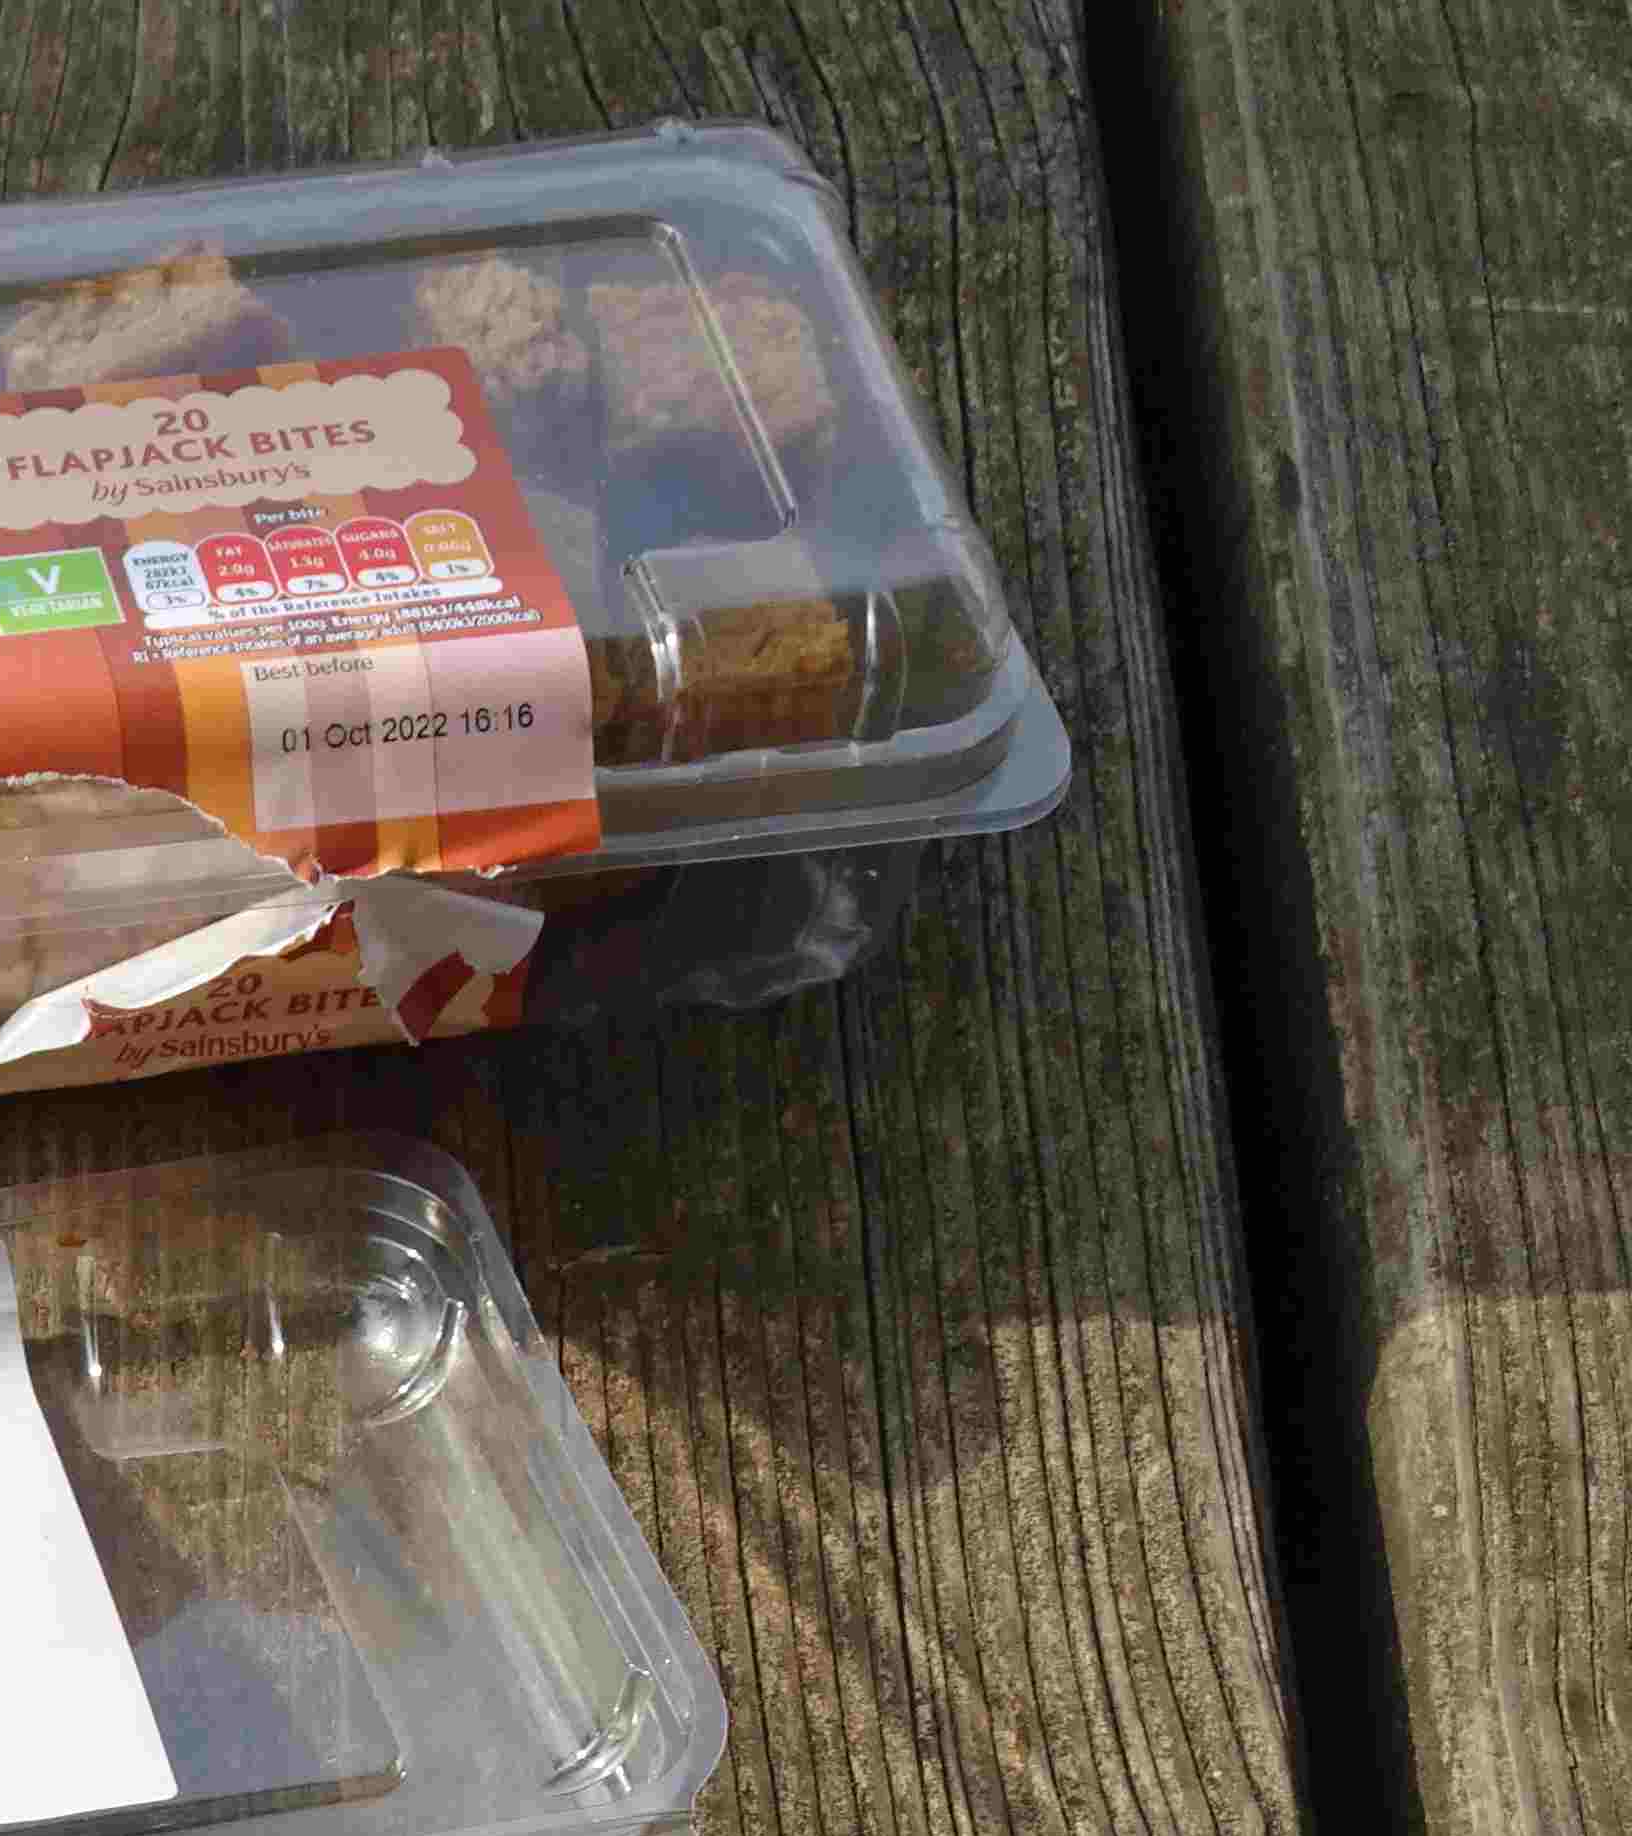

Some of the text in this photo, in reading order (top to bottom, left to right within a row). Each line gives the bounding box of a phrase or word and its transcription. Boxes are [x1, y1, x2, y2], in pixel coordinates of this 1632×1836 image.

[152, 408, 209, 436] 20
[6, 418, 377, 481] FLAPJACK BITES
[91, 460, 314, 506] by Sainsbury's
[341, 528, 401, 543] SUGARS
[132, 551, 189, 567] ENERGY
[215, 545, 243, 558] FAT
[25, 563, 61, 594] V
[9, 596, 104, 617] VEGETARIAN
[249, 602, 279, 616] the
[283, 592, 370, 612] Reference
[254, 655, 375, 682] Best before
[281, 702, 535, 753] 01 Oct 2022 16:16
[207, 971, 263, 1000] 20
[286, 983, 381, 1017] BITE
[112, 1023, 334, 1072] by Sainsbury's
